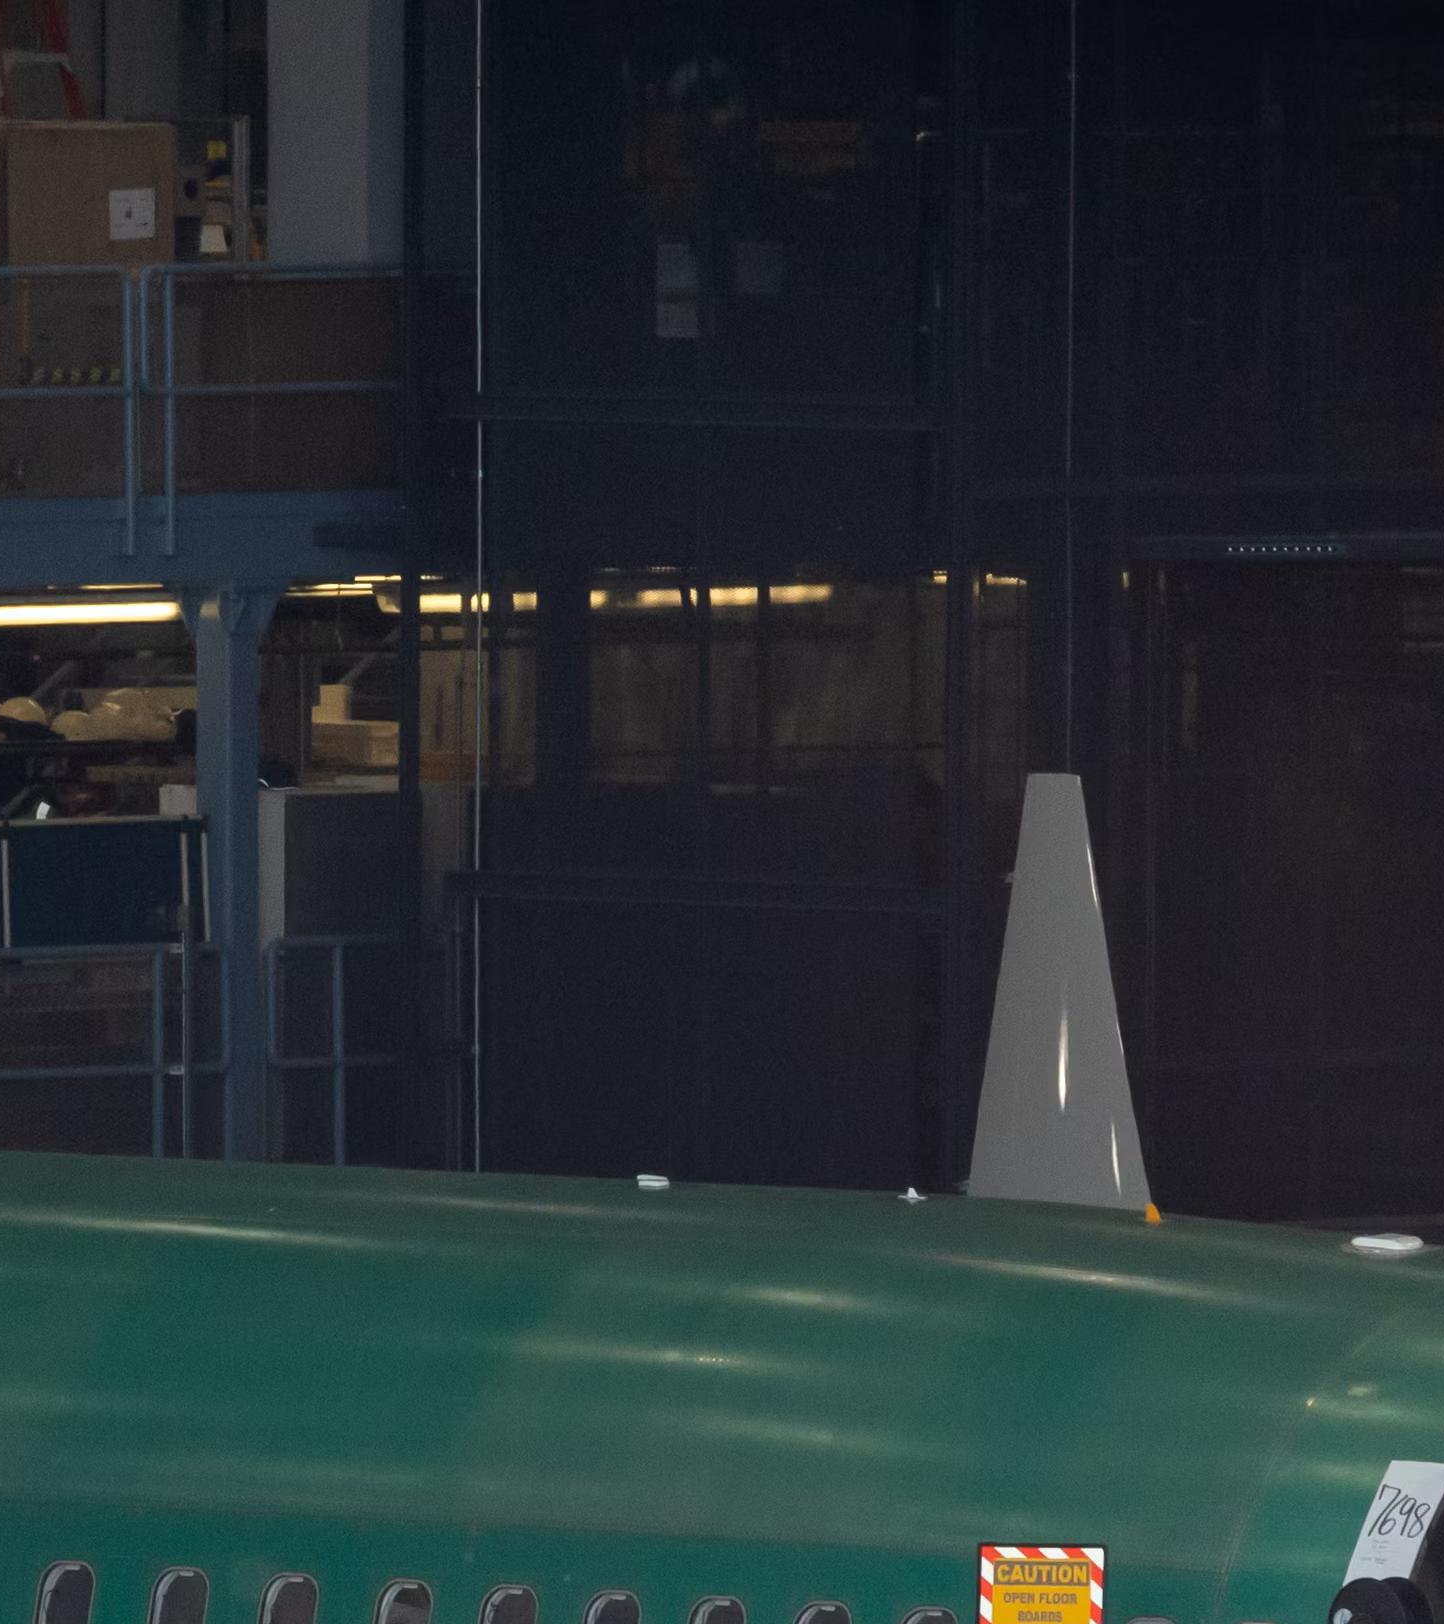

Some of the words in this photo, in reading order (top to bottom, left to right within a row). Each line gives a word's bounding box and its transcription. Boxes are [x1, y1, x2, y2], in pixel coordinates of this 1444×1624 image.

[1368, 1484, 1431, 1538] 7698
[997, 1564, 1087, 1583] CAUTION
[1003, 1592, 1035, 1604] OPEN
[1039, 1592, 1078, 1605] FLOOR
[1017, 1610, 1063, 1623] BOARDS
